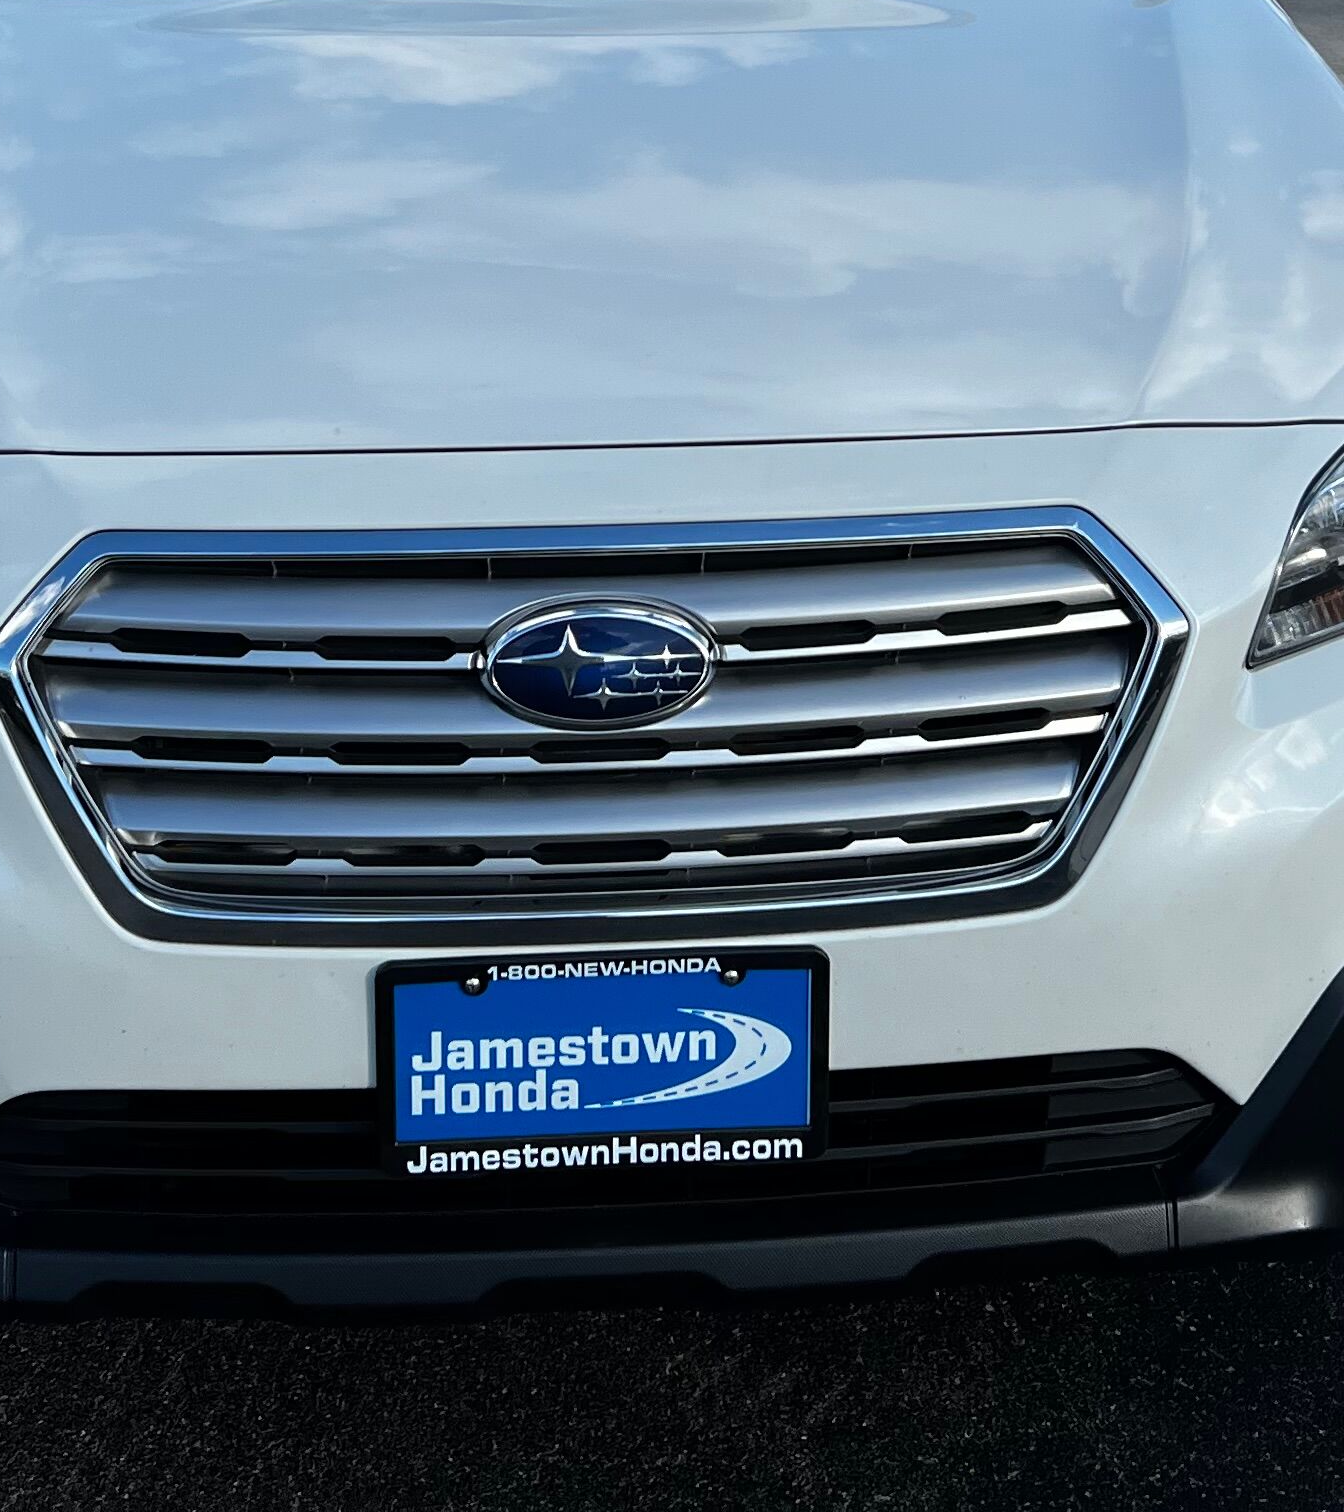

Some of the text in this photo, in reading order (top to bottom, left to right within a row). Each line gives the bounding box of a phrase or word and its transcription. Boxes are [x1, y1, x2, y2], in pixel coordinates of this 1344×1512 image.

[487, 957, 722, 982] 1-800-NEW-HONDA
[411, 1026, 717, 1072] Jamestown
[411, 1068, 580, 1117] Honda
[407, 1134, 803, 1174] JamestownHonda.com
